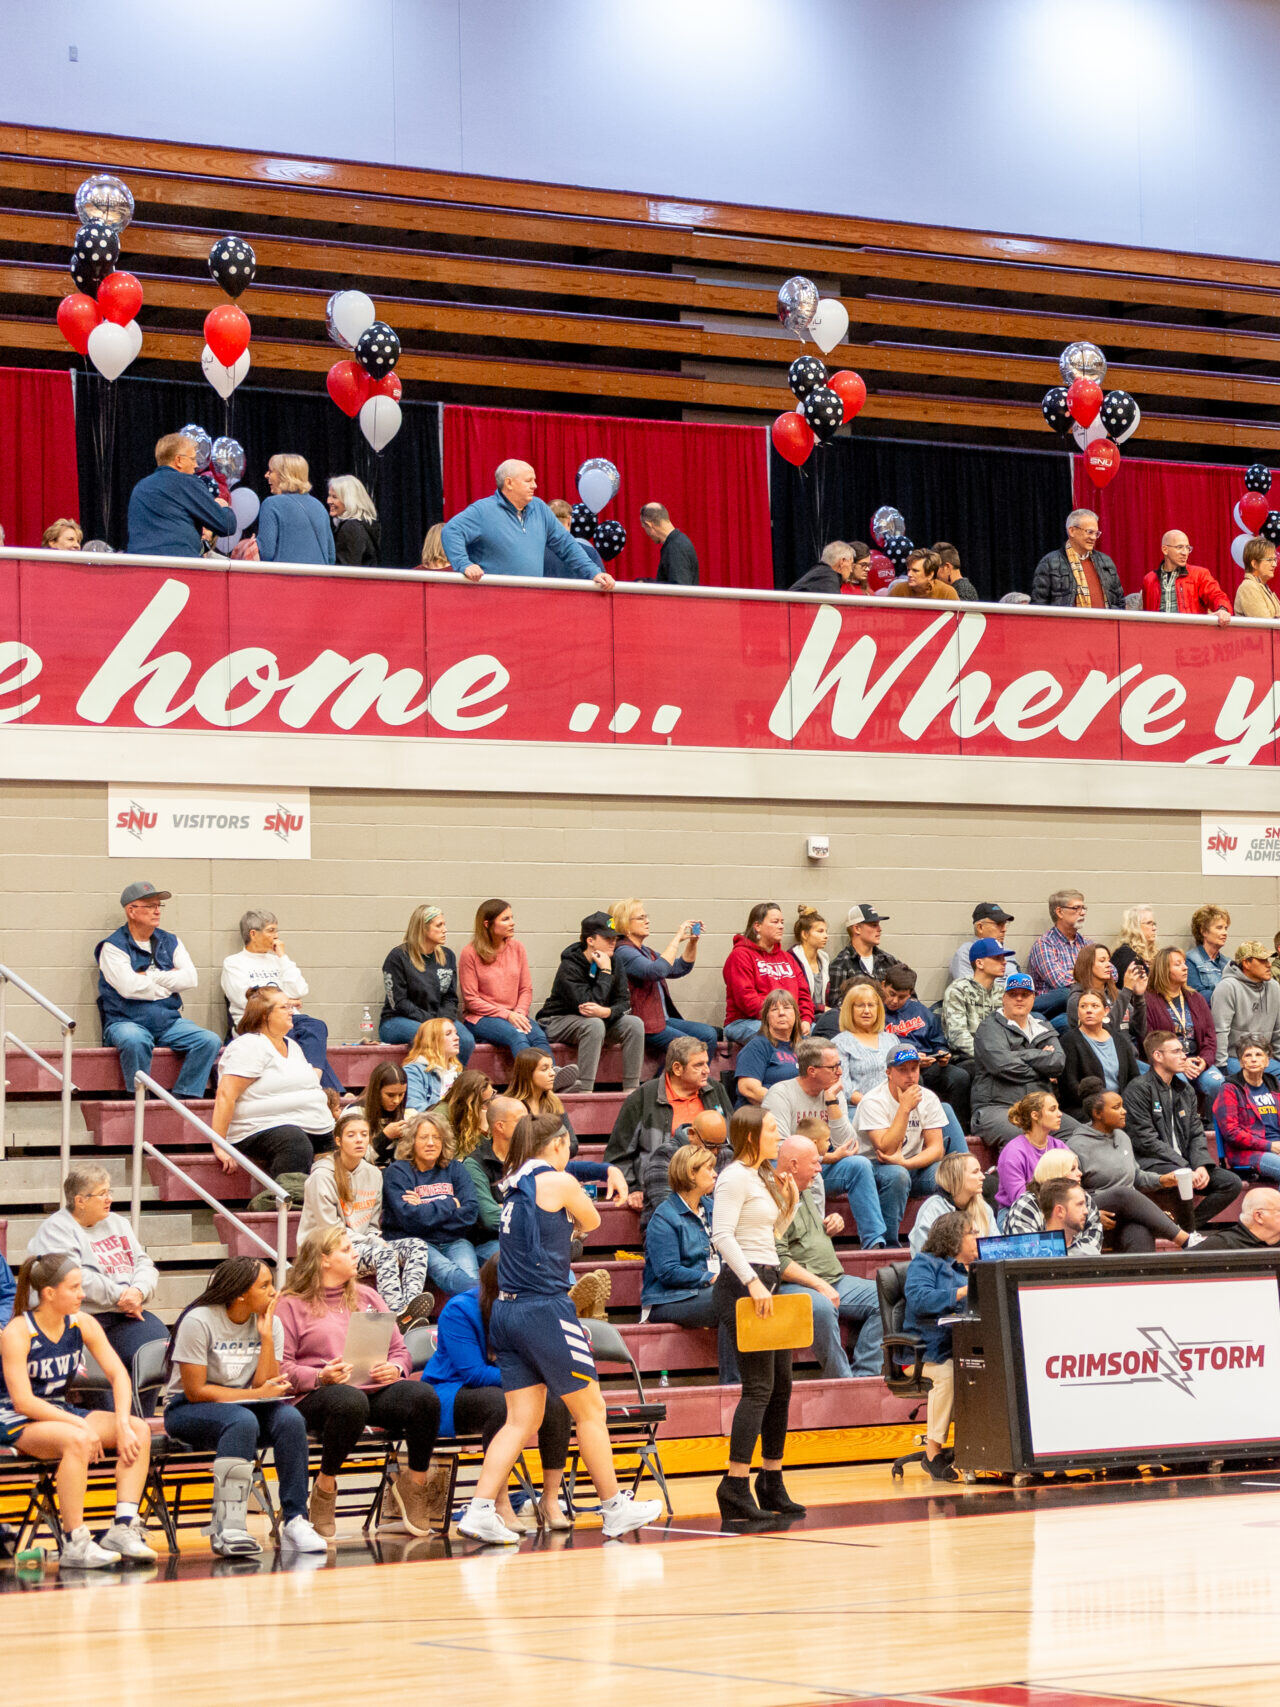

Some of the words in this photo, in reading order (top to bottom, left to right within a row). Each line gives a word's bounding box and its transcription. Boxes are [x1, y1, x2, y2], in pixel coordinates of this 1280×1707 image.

[1090, 457, 1113, 467] SNU
[75, 578, 510, 732] home
[768, 603, 1187, 746] Where
[116, 808, 158, 835] SNU
[172, 813, 250, 830] VISITORS
[263, 809, 304, 836] SNU
[1207, 832, 1238, 855] SNU
[1044, 1350, 1160, 1379] CRIMSON
[1177, 1344, 1266, 1372] STORM
